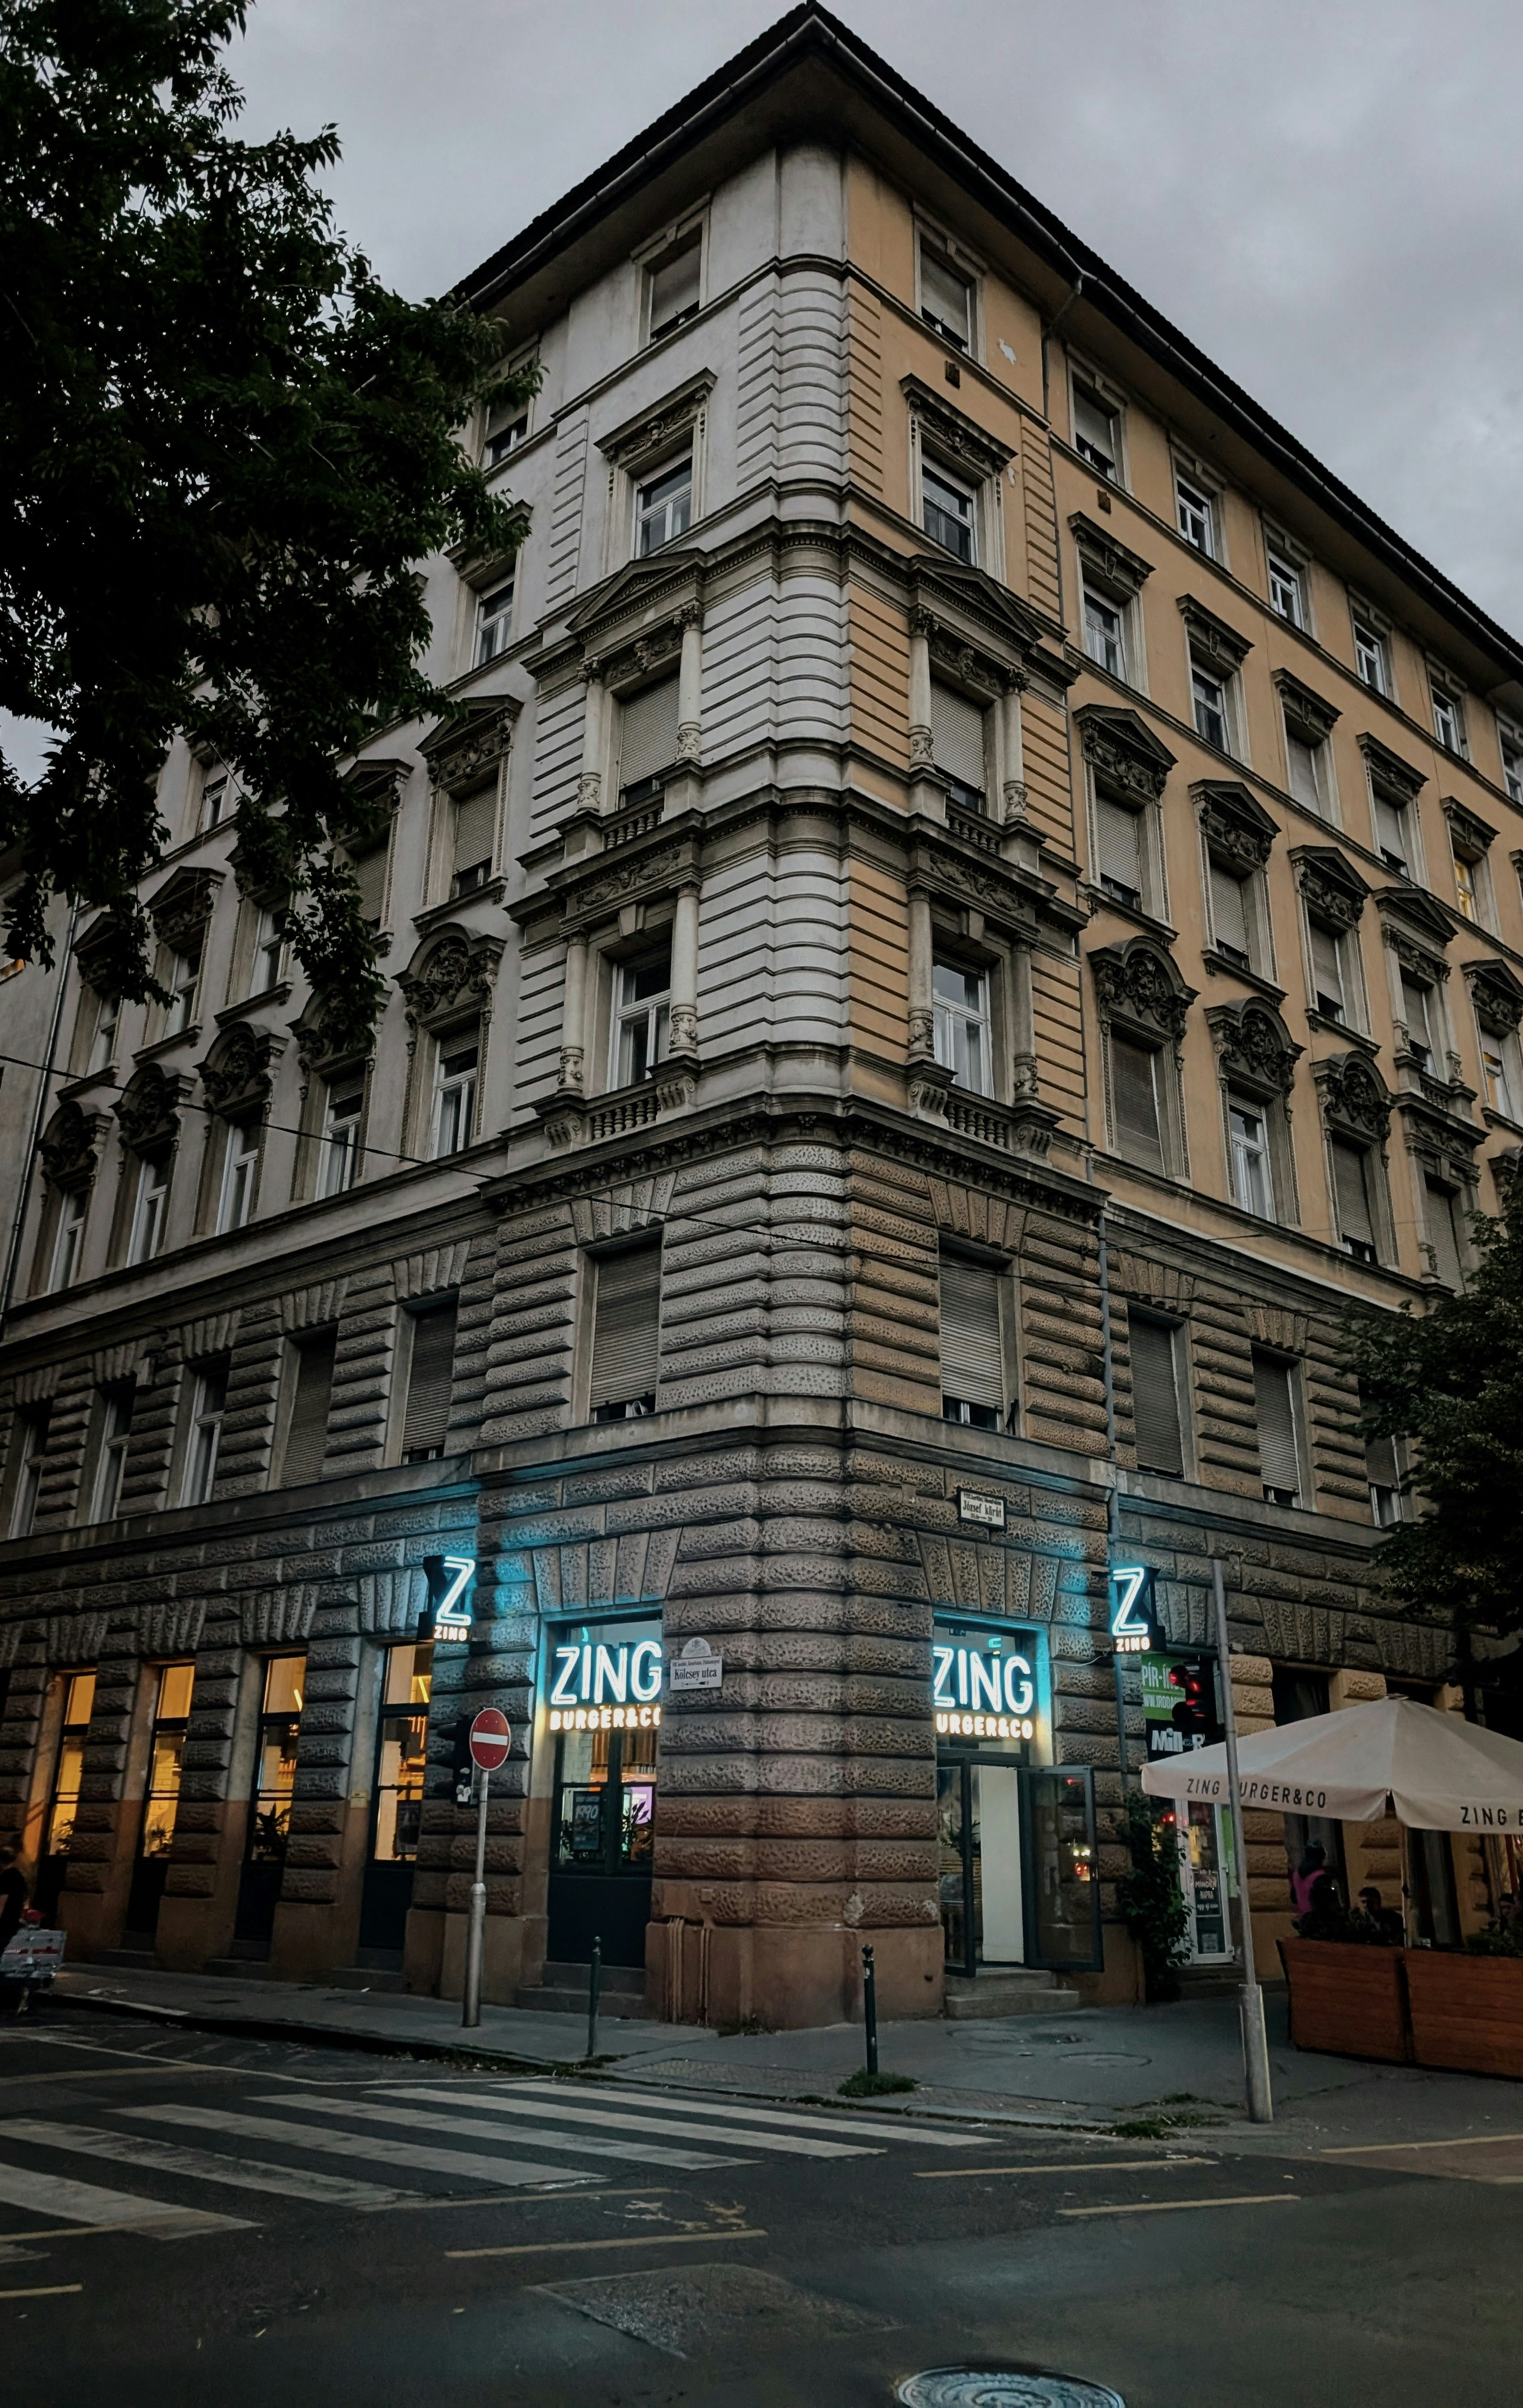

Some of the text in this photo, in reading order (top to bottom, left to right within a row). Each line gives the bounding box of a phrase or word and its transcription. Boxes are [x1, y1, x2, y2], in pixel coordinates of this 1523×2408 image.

[963, 1500, 982, 1513] József
[985, 1504, 1002, 1518] körút
[436, 1556, 475, 1626] Z
[1112, 1567, 1148, 1636] Z
[434, 1625, 468, 1641] ZING
[1116, 1637, 1151, 1652] ZING
[551, 1641, 662, 1705] ZING
[674, 1667, 717, 1681] Kölcsey utca
[933, 1646, 1034, 1715] ZING
[936, 1713, 1033, 1739] URGER&CO
[1187, 1778, 1326, 1808] ZING URGER&CO
[1460, 1806, 1507, 1826] ZING
